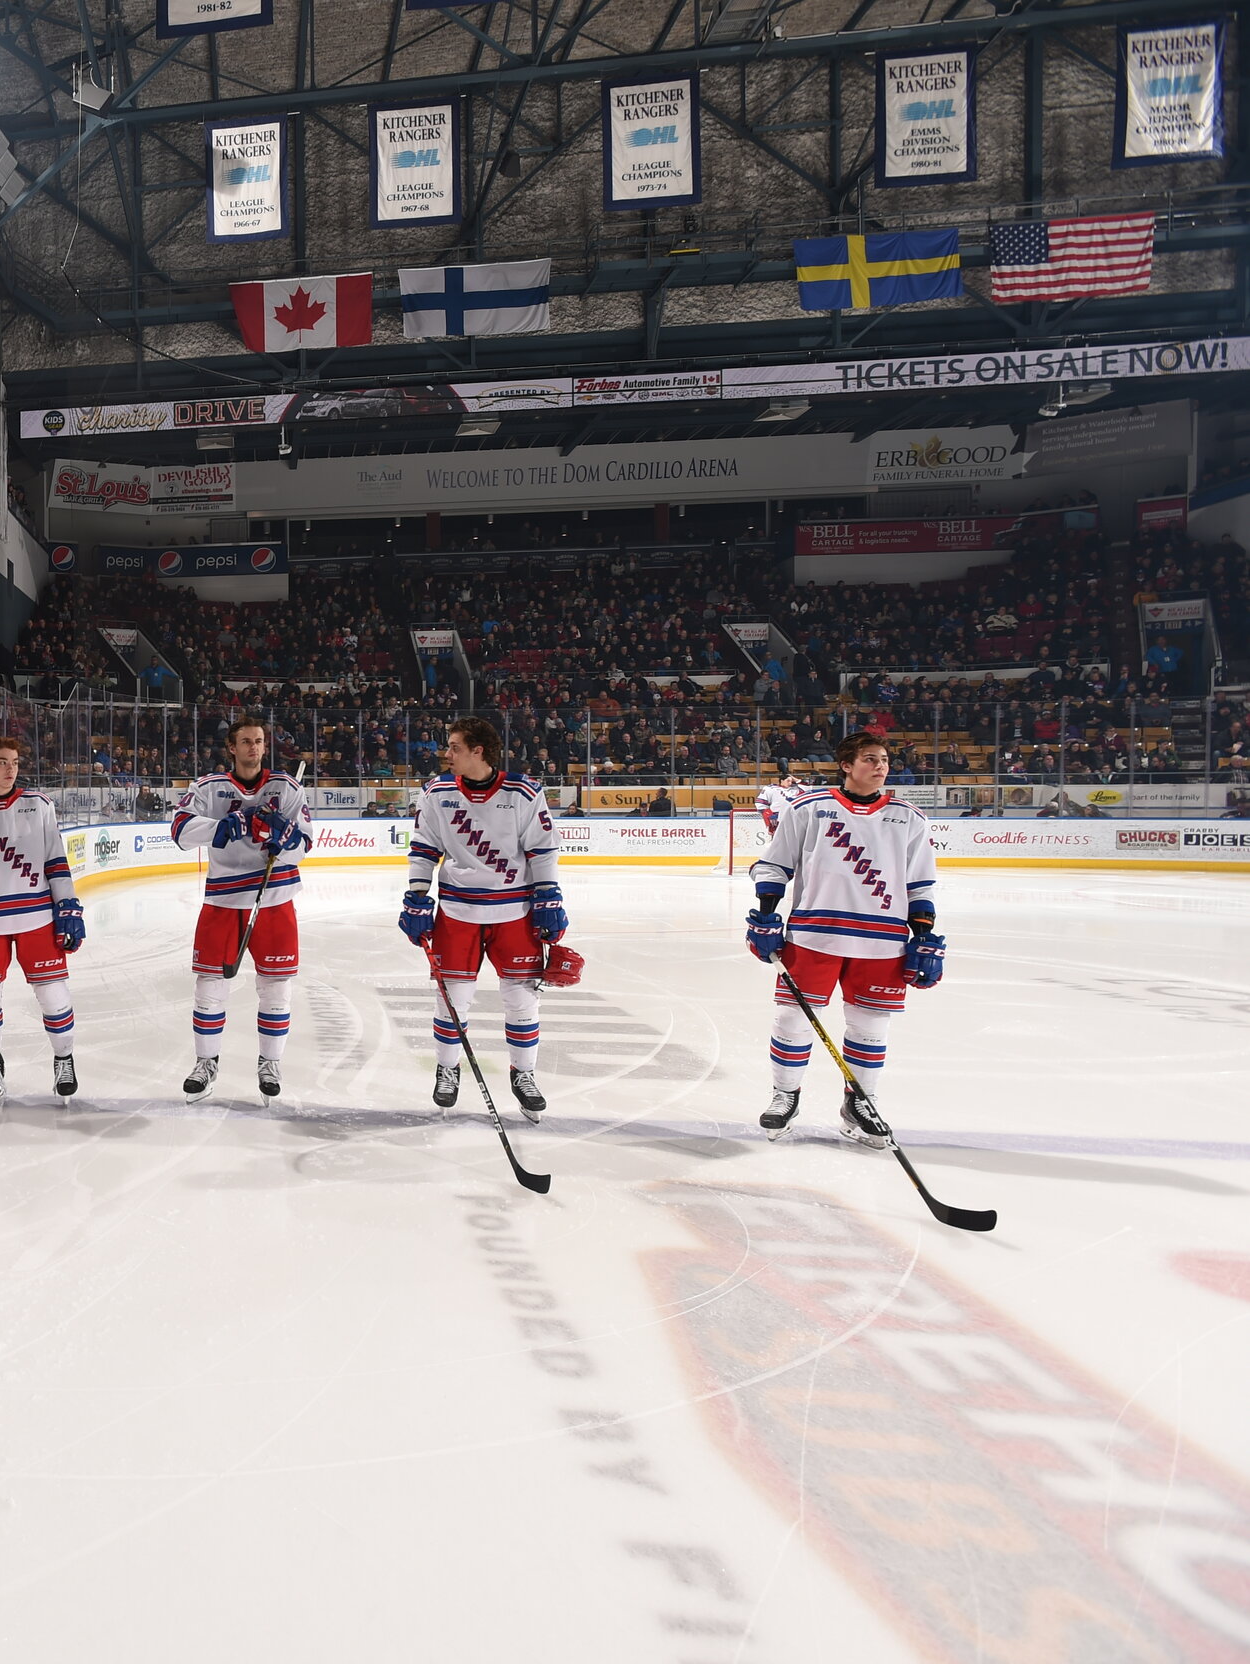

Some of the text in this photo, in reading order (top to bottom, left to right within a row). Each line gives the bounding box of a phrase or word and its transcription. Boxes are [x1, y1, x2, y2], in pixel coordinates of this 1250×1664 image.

[197, 1, 232, 13] 1981-82
[1131, 33, 1212, 53] KITCHENER
[1139, 50, 1204, 69] RANGERS
[889, 60, 963, 80] KITCHENER
[896, 76, 956, 94] RANGERS
[616, 88, 685, 108] KITCHENER
[623, 103, 679, 121] RANGERS
[1150, 103, 1191, 114] MAJOR
[382, 113, 446, 130] KITCHENER
[1148, 112, 1193, 124] JUNIOR
[389, 127, 441, 143] RANGERS
[910, 126, 941, 136] EMMS
[215, 130, 276, 148] KITCHENER
[902, 135, 951, 146] DIVISION
[222, 144, 271, 160] RANGERS
[893, 144, 960, 157] CHAMPIONS
[632, 160, 671, 171] LEAGUE
[910, 160, 942, 168] 1980-81
[621, 169, 682, 181] CHAMPIONS
[396, 183, 434, 192] LEAGUE
[636, 183, 668, 192] 1973-74
[386, 190, 444, 202] CHAMPIONS
[230, 198, 265, 209] LEAGUE
[400, 204, 430, 213] 1967-68
[220, 205, 275, 217] CHAMPIONS
[233, 219, 261, 228] 1966-67
[835, 341, 1229, 390] TICKETS ON SALE NOW!
[575, 376, 700, 393] Forbes Automotive Family
[489, 389, 537, 398] PRESENTED
[44, 416, 63, 424] KIDS
[76, 398, 266, 432] charity DRIVE
[1042, 424, 1077, 436] Kitchener
[1067, 439, 1093, 449] funeral
[1095, 436, 1117, 445] home
[876, 446, 1007, 468] ERB GOOD
[158, 465, 233, 483] DEVILISHLY
[357, 469, 402, 482] The Aud
[426, 467, 499, 489] WELCOME
[503, 467, 524, 486] TO
[527, 466, 558, 485] THE
[562, 462, 601, 484] DOM
[605, 459, 683, 483] CARDILLO
[686, 457, 738, 479] ARENA
[873, 467, 1004, 482] FAMILY FUNERAL HOME
[813, 524, 855, 538] BELL
[892, 529, 918, 538] trucking
[937, 520, 982, 534] BELL
[864, 538, 890, 546] logistics
[106, 555, 144, 570] pepsi
[195, 553, 238, 570] pepsi
[615, 793, 642, 805] Sun
[728, 791, 755, 804] Sun
[1175, 794, 1200, 802] family
[815, 809, 838, 820] OHL
[882, 817, 908, 825] CCM
[317, 827, 375, 848] Hortons
[620, 828, 658, 838] PICKLE
[661, 828, 707, 838] BARREL
[972, 831, 1090, 845] GoodLife FITNESS
[1119, 831, 1177, 844] CHUCK'S
[94, 839, 120, 856] moser
[451, 810, 518, 884] RANGERS
[825, 822, 892, 910] RANGERS
[34, 958, 63, 968] CCM
[560, 1407, 669, 1495] BY
